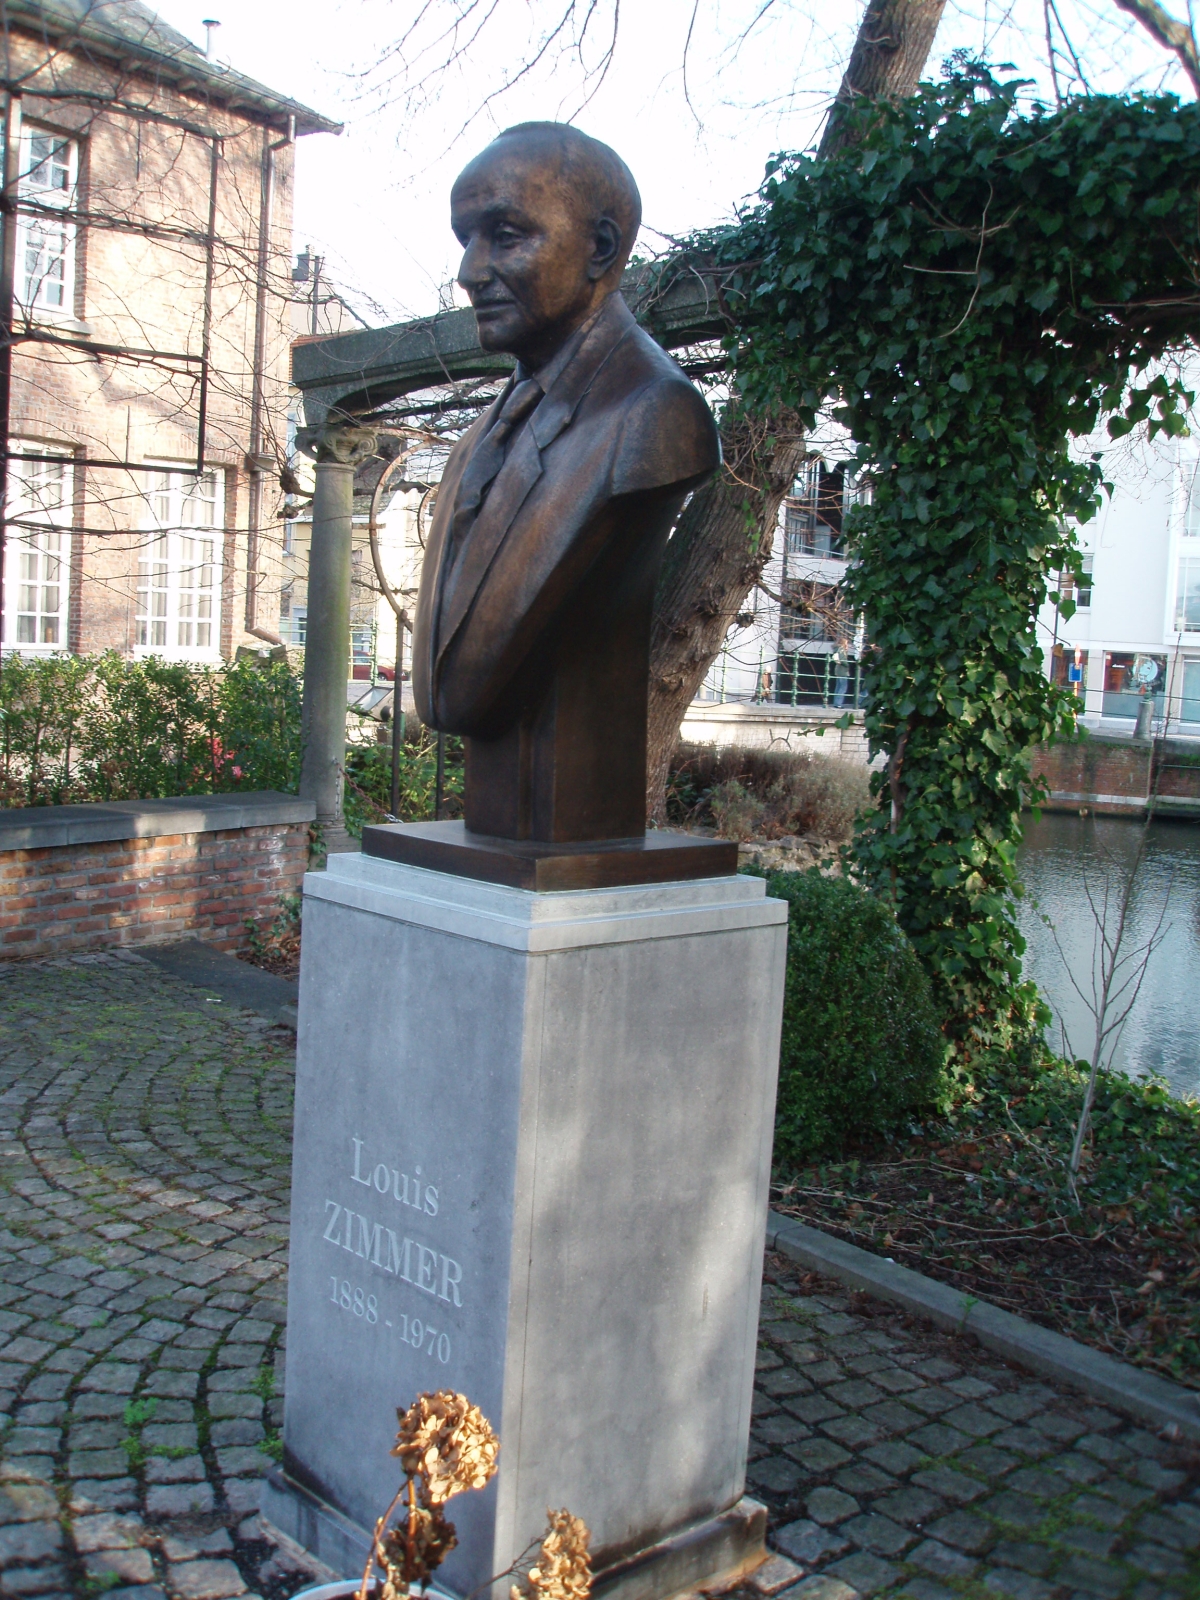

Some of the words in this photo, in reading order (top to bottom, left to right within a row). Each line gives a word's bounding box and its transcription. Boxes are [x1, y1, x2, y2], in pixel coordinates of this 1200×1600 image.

[351, 1137, 440, 1216] Louis
[323, 1199, 463, 1308] ZIMMER
[330, 1276, 378, 1325] 1888
[399, 1313, 451, 1364] 1970
